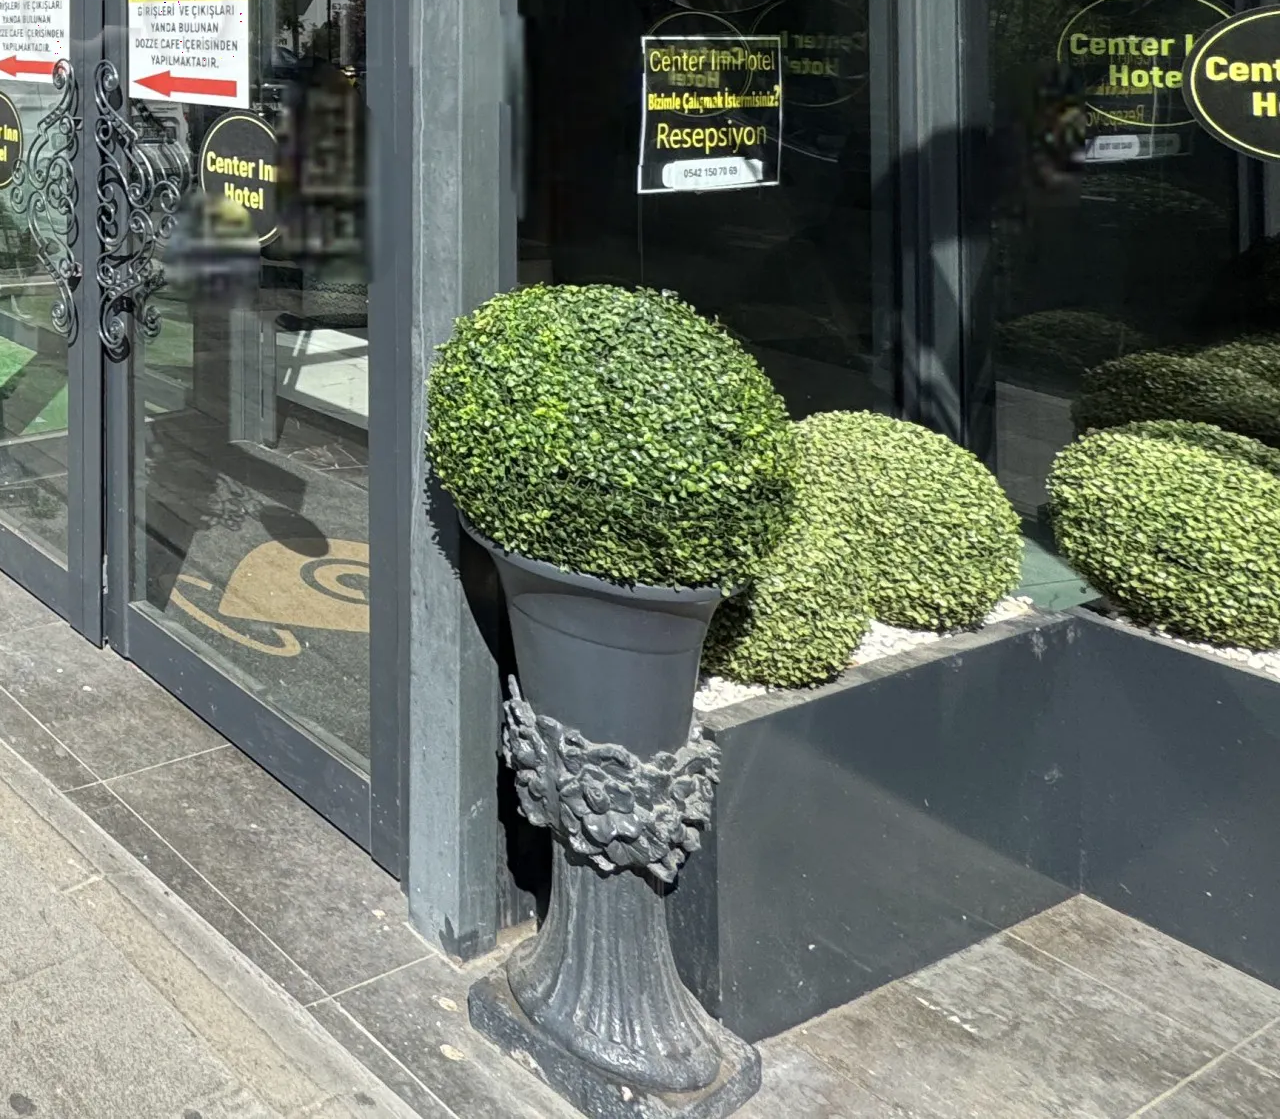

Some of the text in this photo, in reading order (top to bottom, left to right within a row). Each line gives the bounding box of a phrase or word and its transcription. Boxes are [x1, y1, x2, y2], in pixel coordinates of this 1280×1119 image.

[179, 5, 189, 16] VE
[191, 4, 235, 19] ÇIKIŞLARI
[9, 28, 24, 37] CAFE
[150, 22, 219, 33] YANDA BULUNAN
[135, 38, 159, 49] DOZZE
[160, 38, 180, 49] CAFE
[1070, 33, 1176, 57] Center
[650, 50, 706, 72] Center
[738, 50, 775, 71] Hotel
[1109, 64, 1183, 89] Hote
[648, 92, 681, 110] Bizimle
[683, 90, 724, 114] Çalışmak
[1252, 91, 1280, 117] H
[3, 124, 19, 143] Inn
[656, 120, 767, 155] Resepsiyon
[206, 151, 256, 179] Center
[224, 181, 264, 210] Hotel
